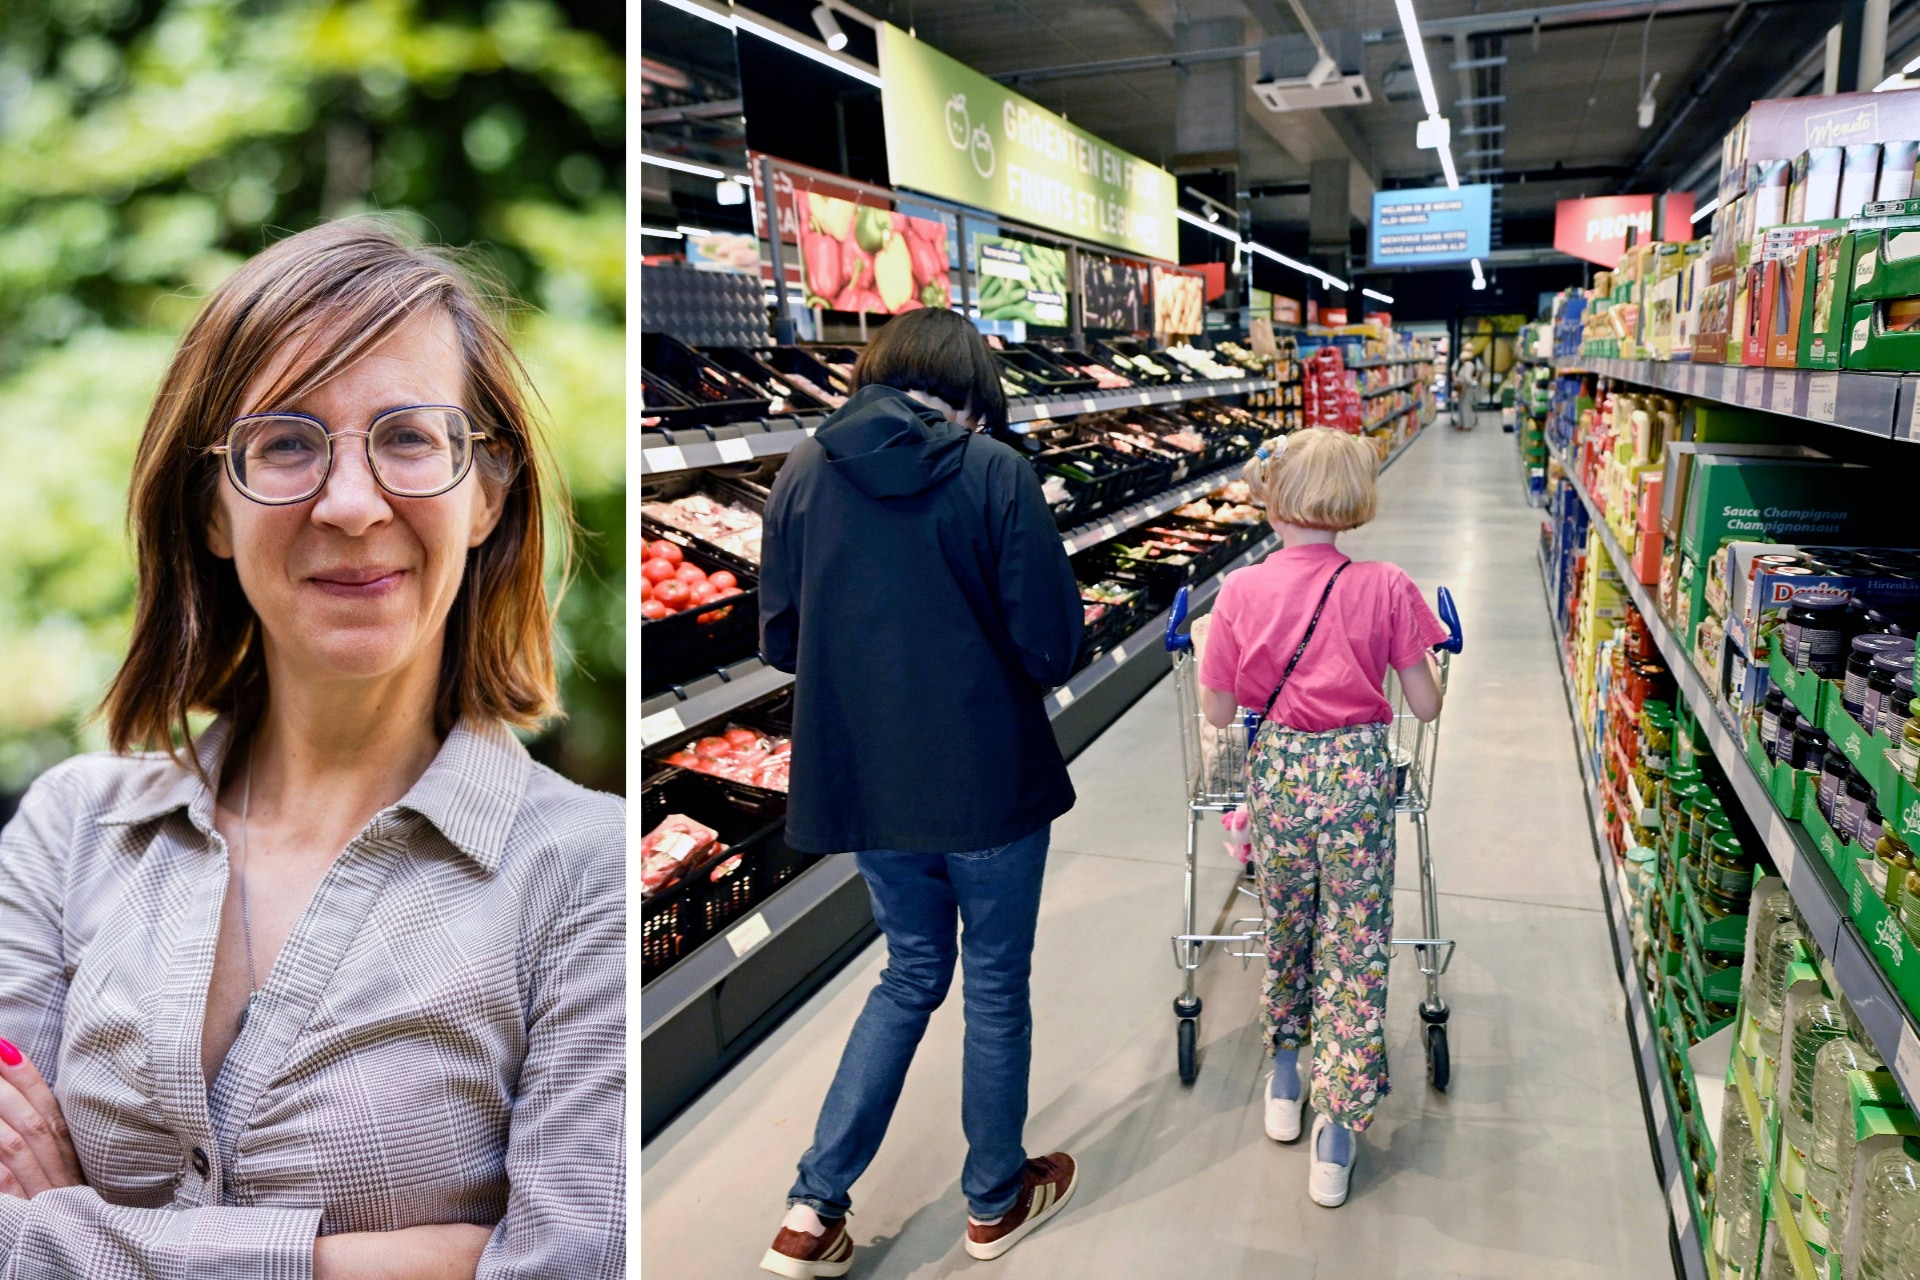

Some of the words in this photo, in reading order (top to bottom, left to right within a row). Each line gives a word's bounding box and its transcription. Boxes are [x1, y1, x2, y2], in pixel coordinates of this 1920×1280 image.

[1003, 99, 1099, 178] GROENTEN
[1102, 149, 1122, 187] EN
[1006, 163, 1074, 222] FRUITS
[1077, 189, 1096, 227] ET
[1722, 506, 1760, 517] Sauce
[1763, 507, 1847, 521] Champignon
[1727, 519, 1841, 533] Champignonsaus
